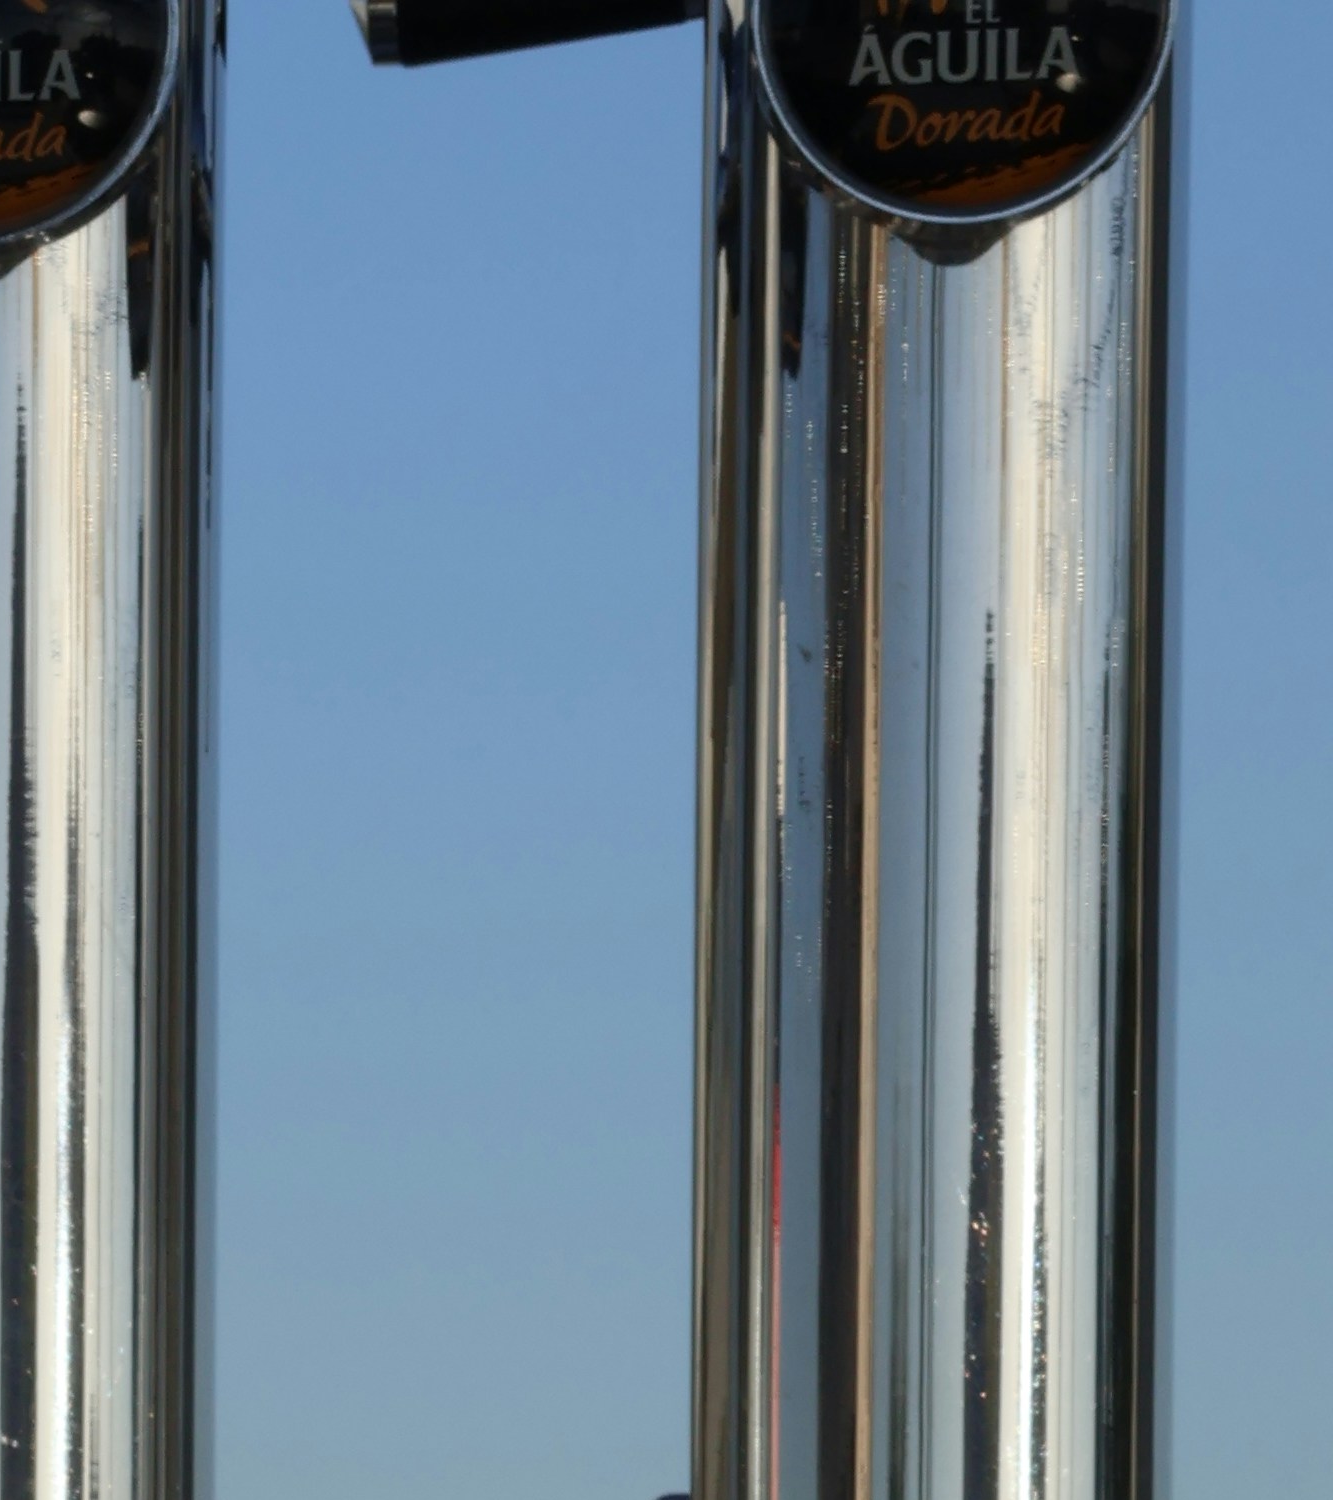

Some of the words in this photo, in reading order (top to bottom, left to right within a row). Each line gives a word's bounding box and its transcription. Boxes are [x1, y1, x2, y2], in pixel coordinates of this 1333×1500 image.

[965, 0, 1000, 24] EL
[848, 25, 1081, 87] ÁGUILA
[867, 90, 1065, 151] Dorada
